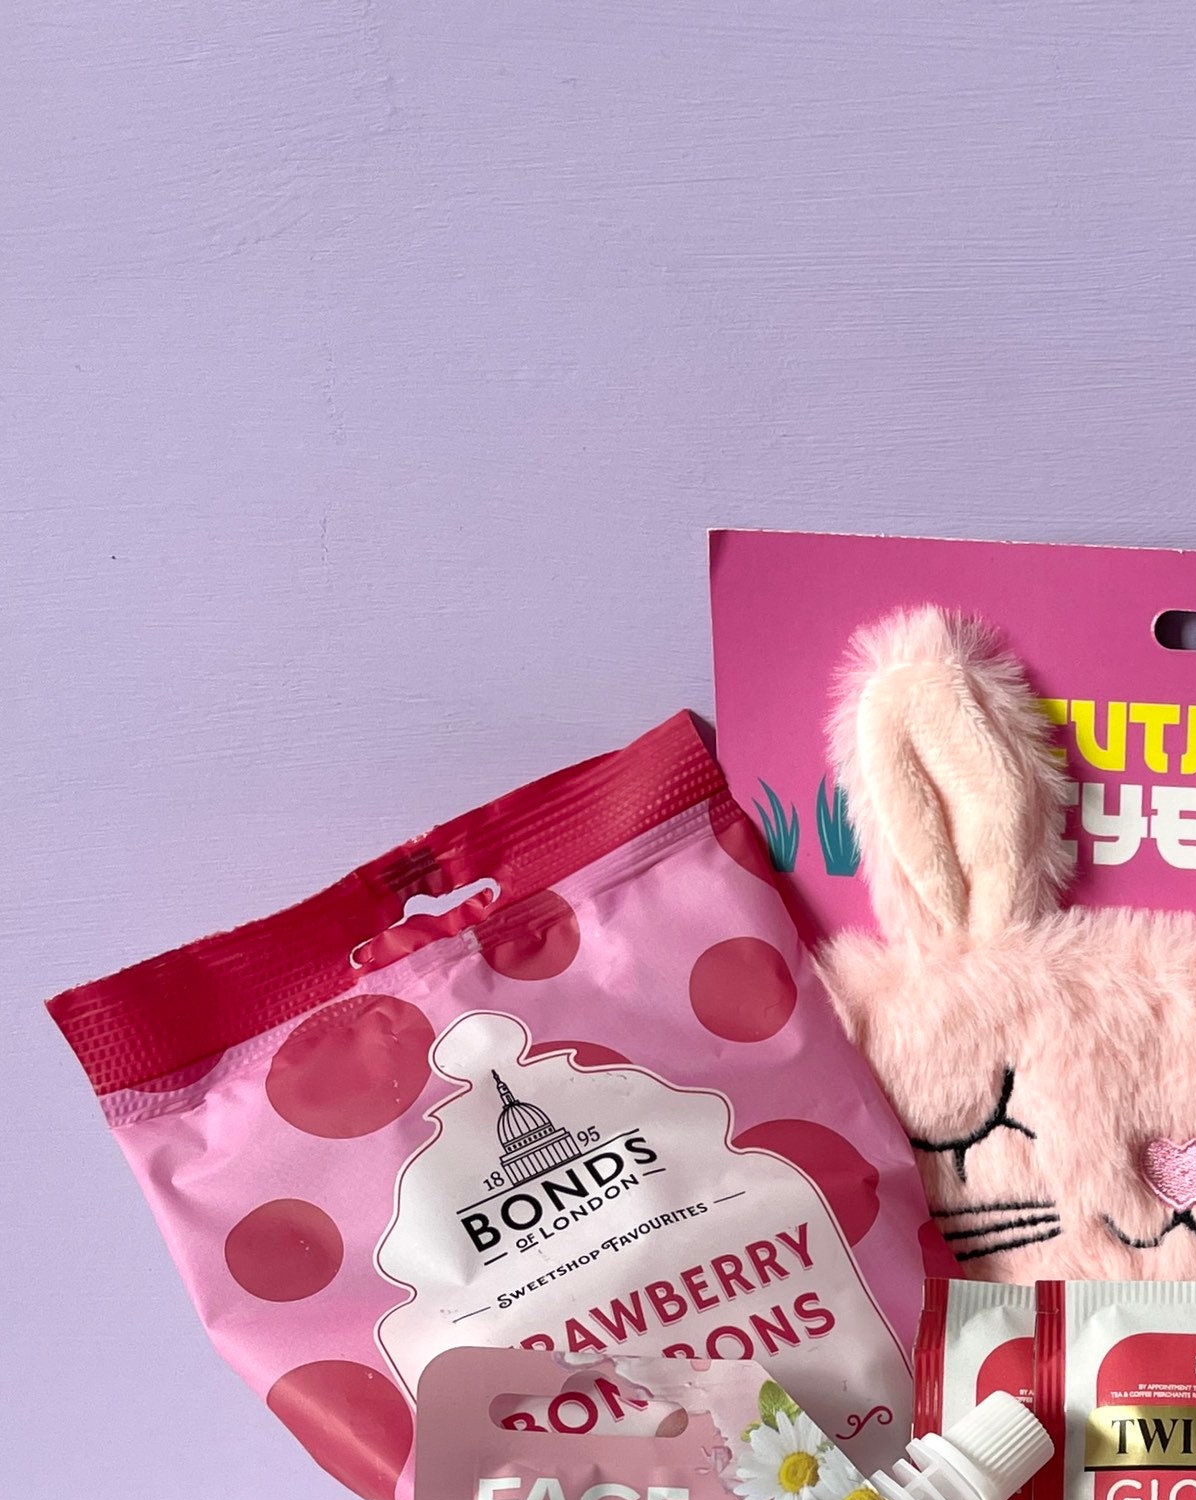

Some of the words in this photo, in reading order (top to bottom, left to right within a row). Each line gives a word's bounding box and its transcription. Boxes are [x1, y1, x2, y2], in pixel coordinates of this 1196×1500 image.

[482, 1170, 506, 1192] 18
[576, 1125, 602, 1148] 95
[460, 1136, 658, 1253] BONDS
[515, 1232, 537, 1250] OF
[538, 1172, 640, 1241] LONDON
[1110, 1391, 1123, 1399] TEA
[1129, 1390, 1152, 1399] COFFEE
[1153, 1391, 1191, 1400] MERCHANTS
[1147, 1383, 1192, 1392] APPOINTMENT
